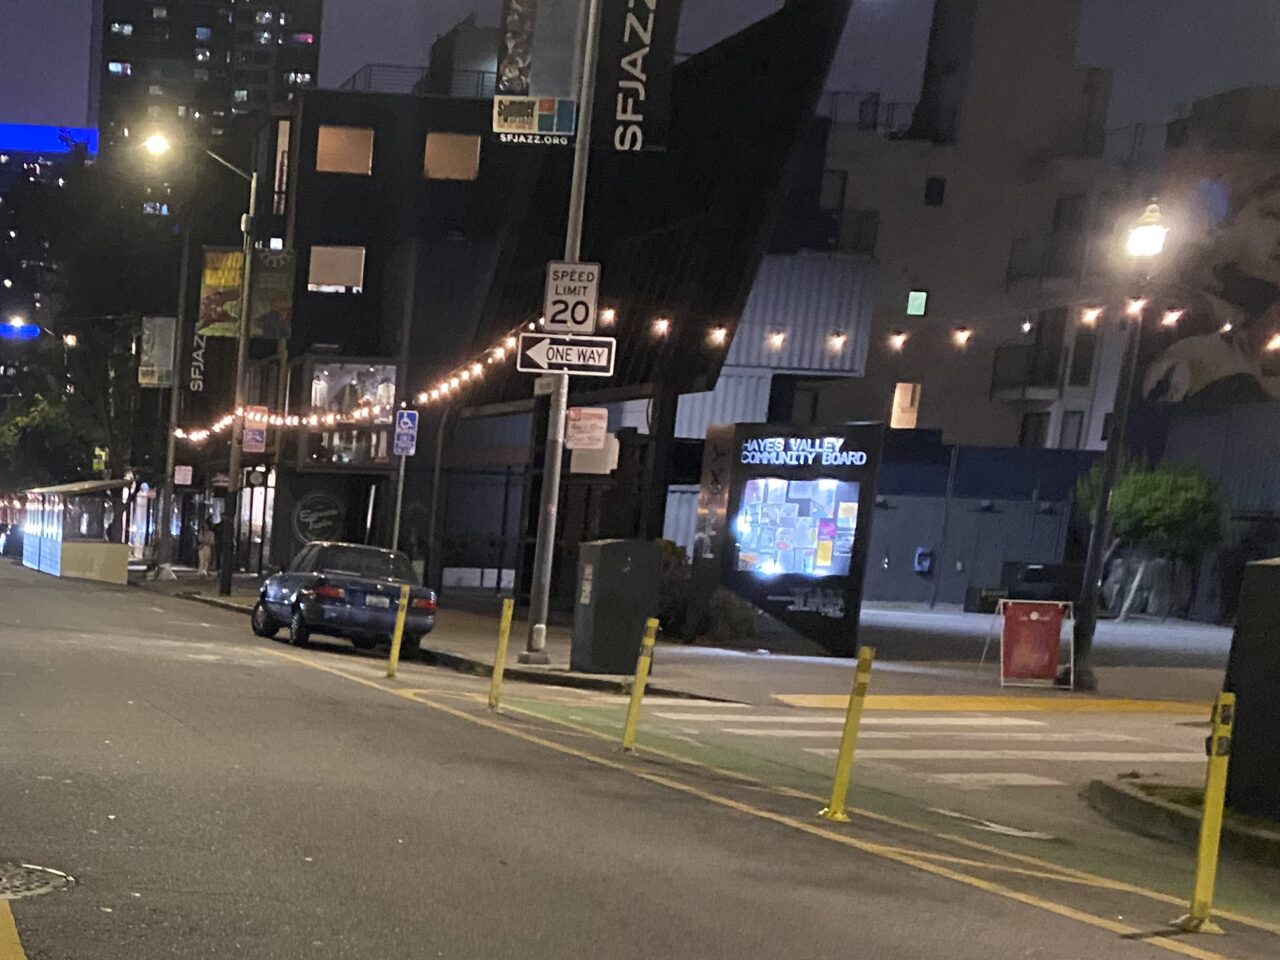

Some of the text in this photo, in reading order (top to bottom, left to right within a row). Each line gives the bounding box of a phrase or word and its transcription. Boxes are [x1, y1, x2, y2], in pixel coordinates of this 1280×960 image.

[500, 133, 568, 145] SFJAZZ.ORG
[552, 270, 595, 281] SPEED
[555, 285, 588, 296] LIMIT
[550, 299, 589, 325] 20
[546, 347, 604, 364] ONE WAY
[742, 437, 844, 452] HAYES VALLEY
[741, 451, 867, 465] COMMUNITY BOARD
